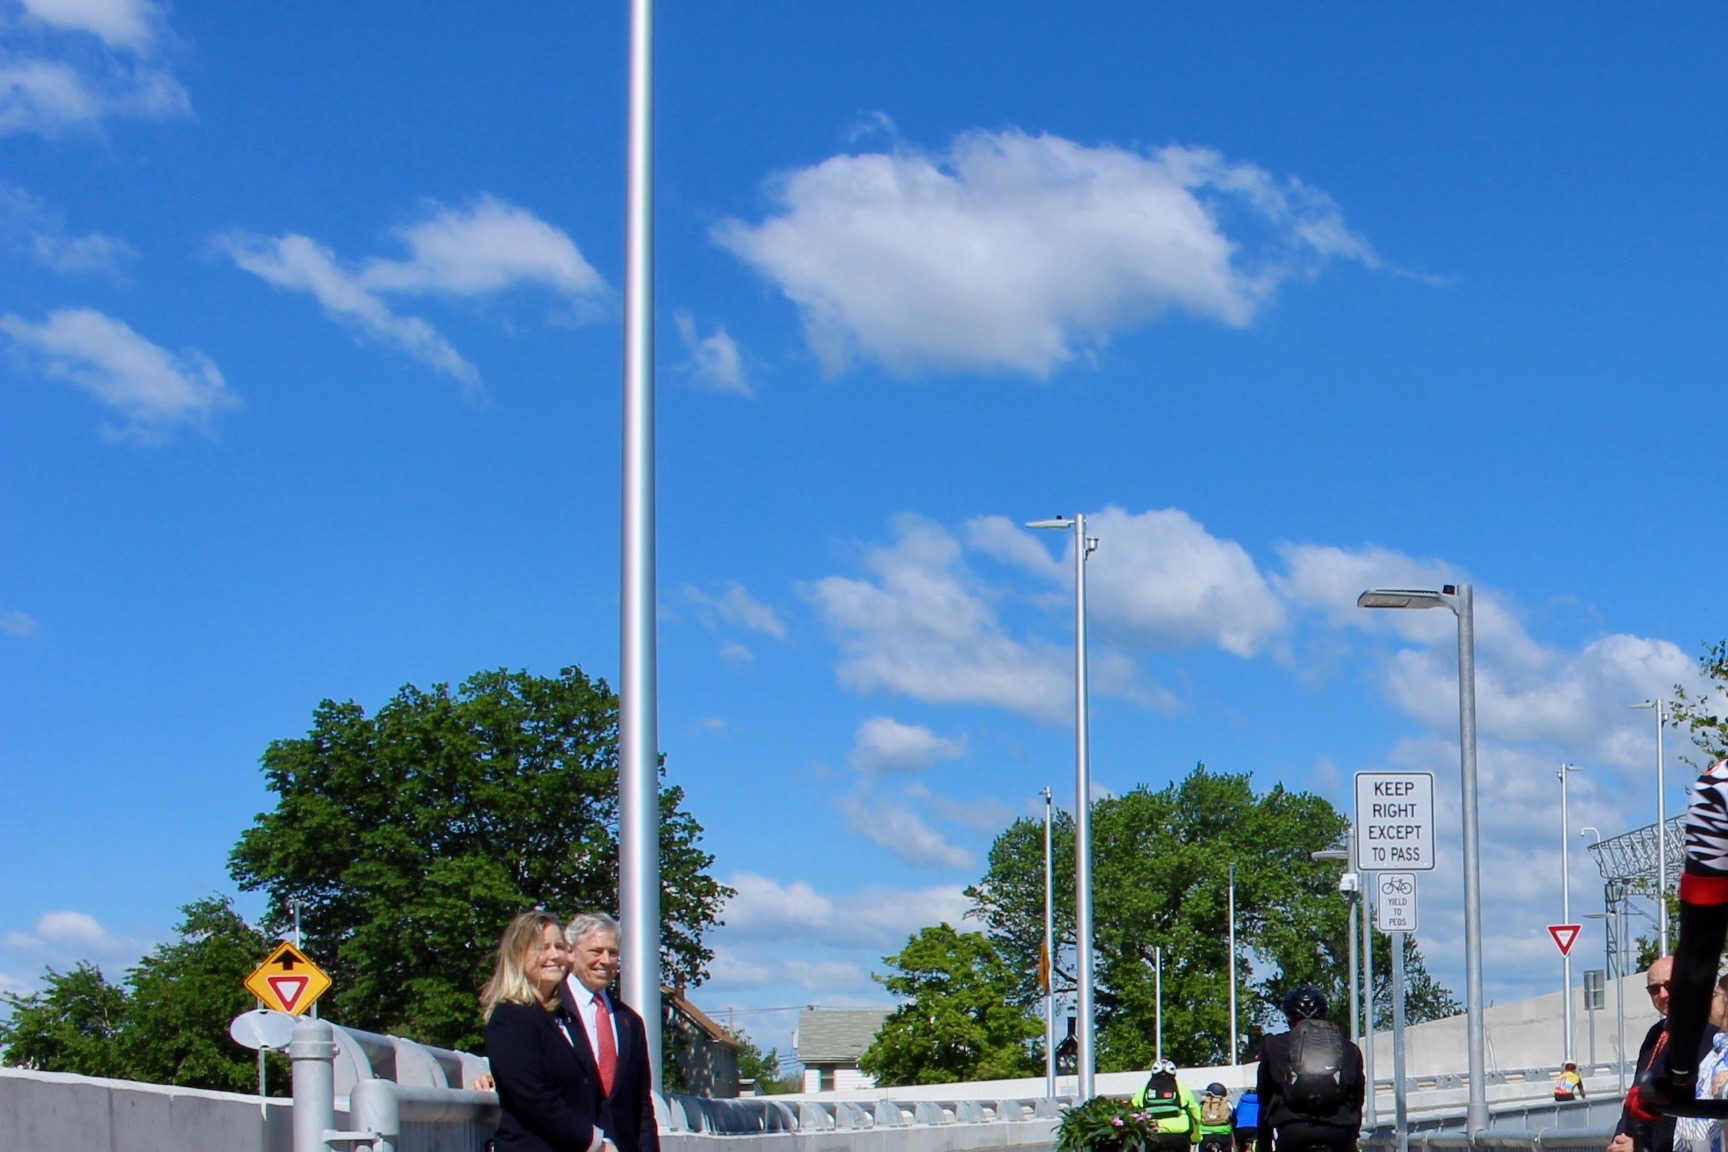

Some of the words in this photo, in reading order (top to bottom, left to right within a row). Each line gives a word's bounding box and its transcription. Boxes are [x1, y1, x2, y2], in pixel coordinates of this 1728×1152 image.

[1374, 781, 1415, 796] KEEP
[1373, 803, 1417, 818] RIGHT
[1369, 825, 1422, 840] EXCEPT
[1372, 847, 1386, 862] TO
[1391, 847, 1420, 862] PASS
[1388, 898, 1407, 906] YIELD
[1393, 908, 1402, 916] TO
[1389, 918, 1406, 926] PEDS
